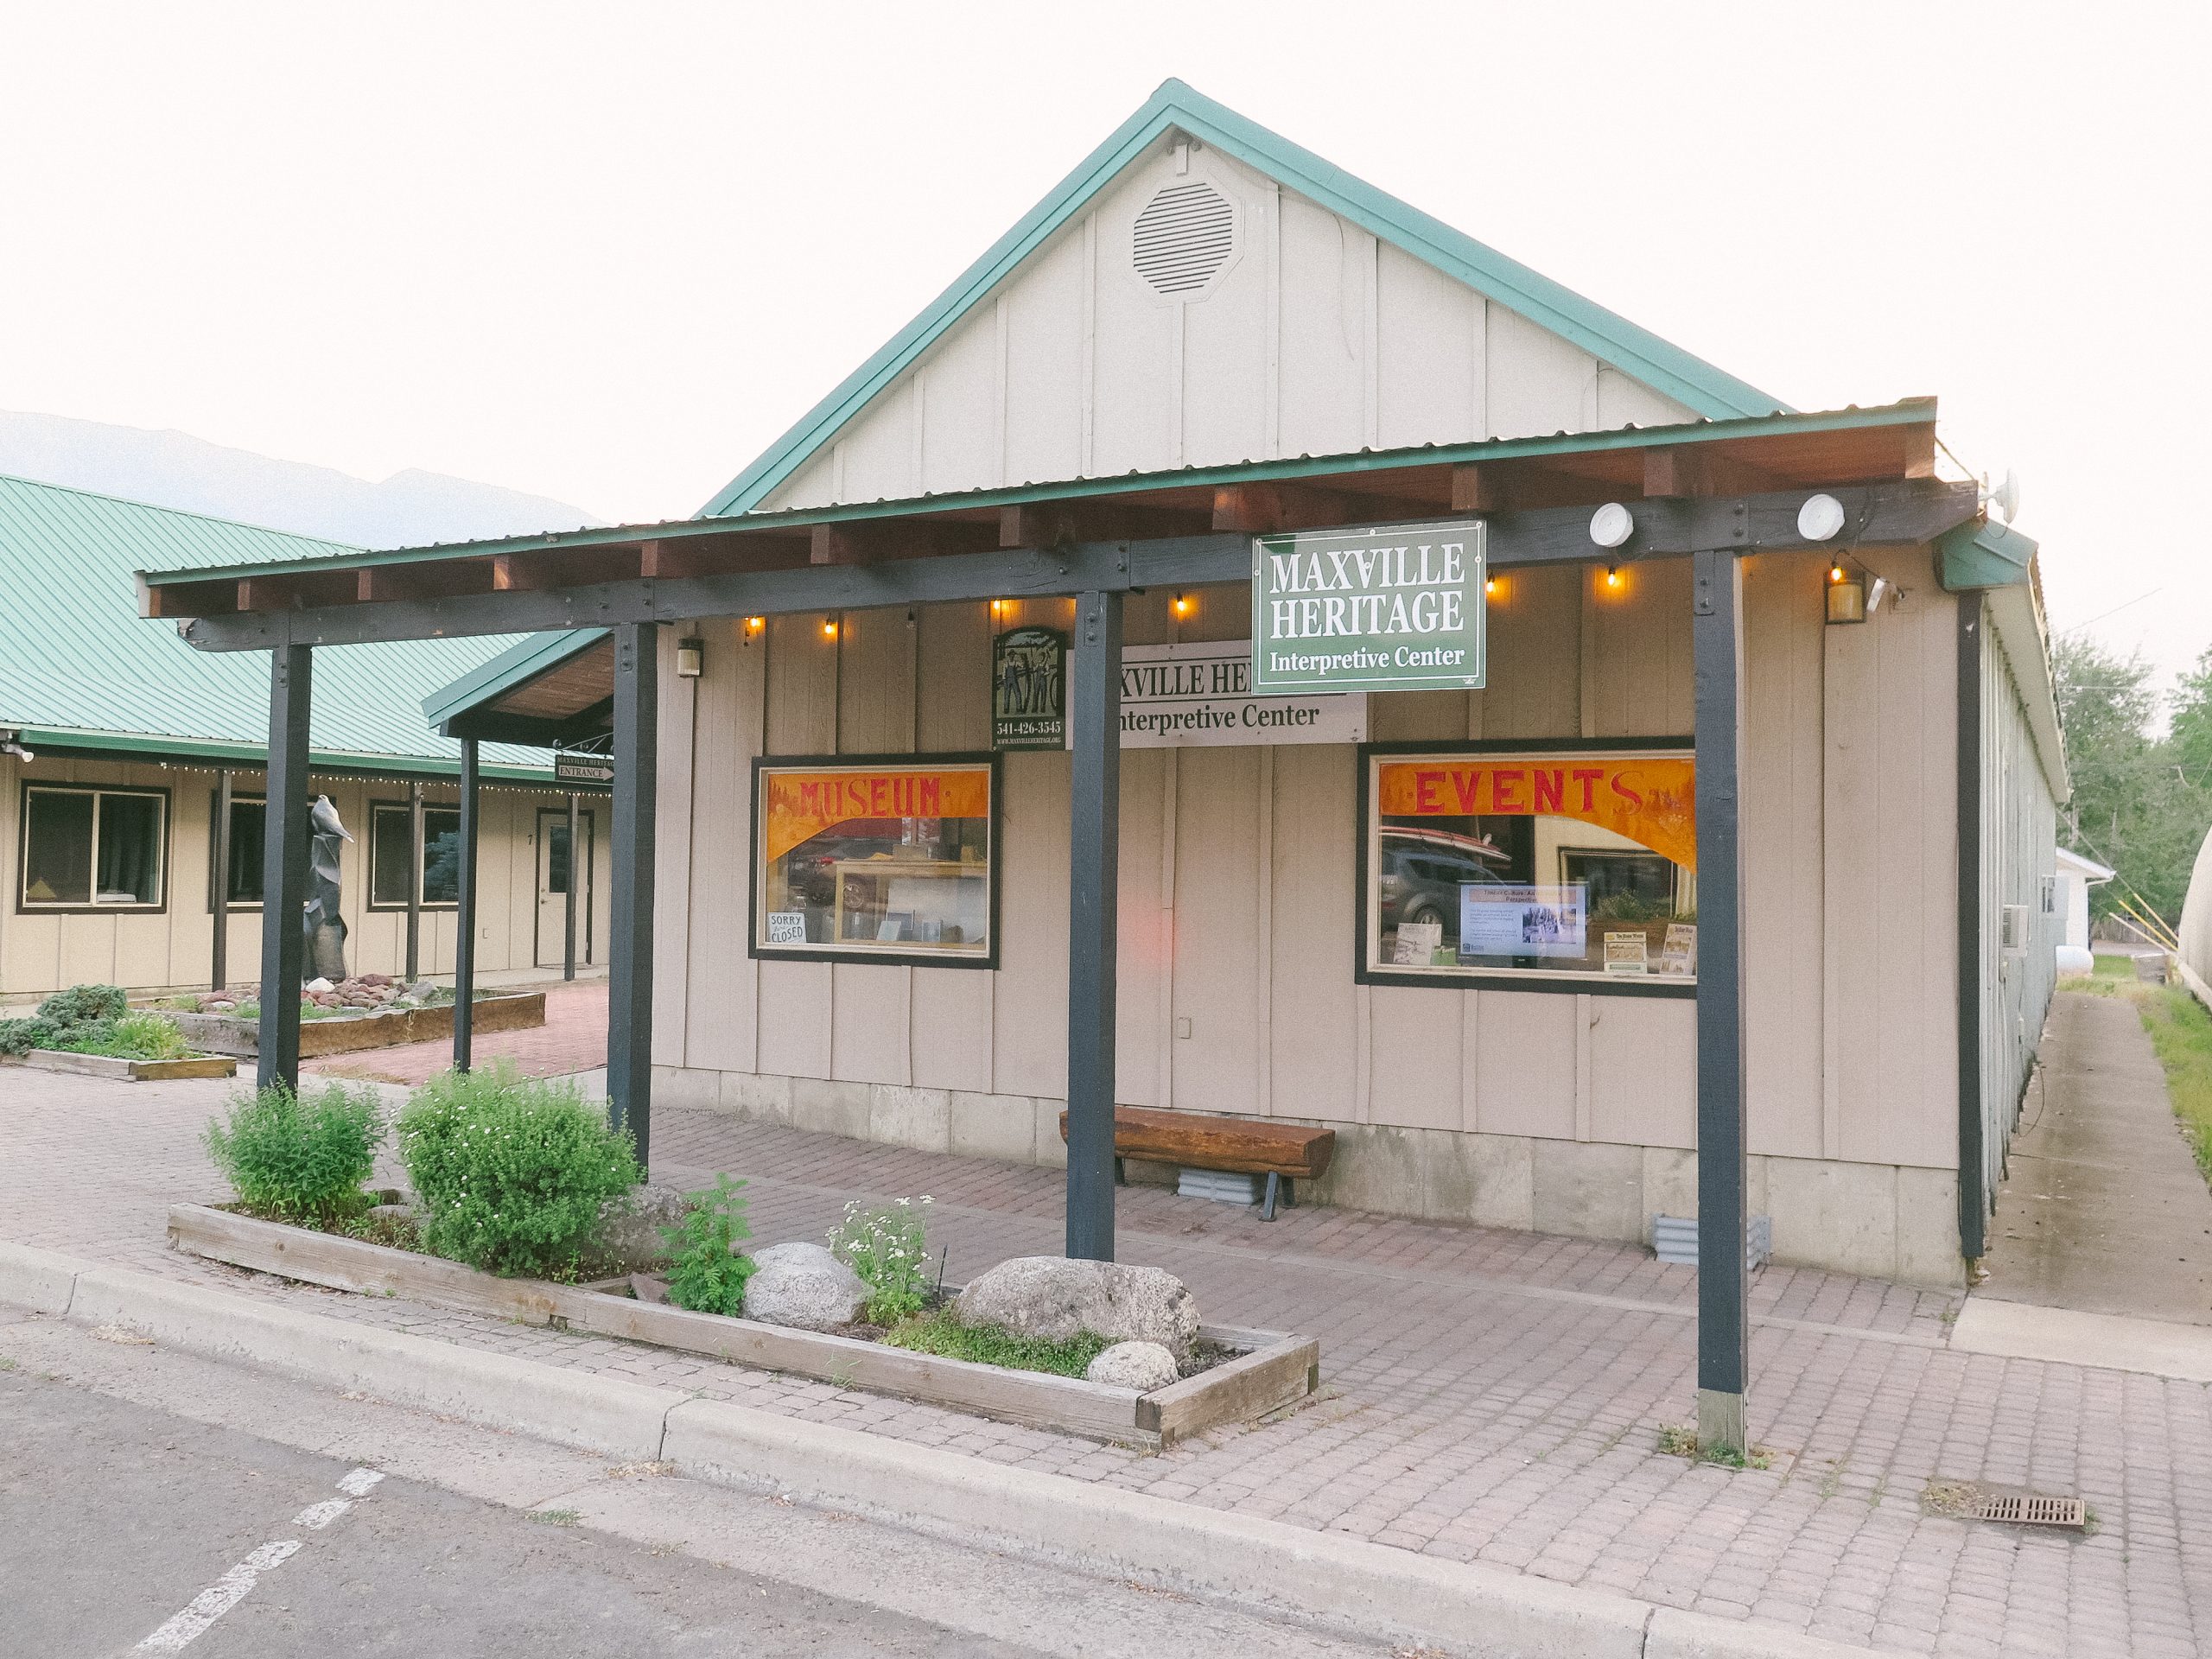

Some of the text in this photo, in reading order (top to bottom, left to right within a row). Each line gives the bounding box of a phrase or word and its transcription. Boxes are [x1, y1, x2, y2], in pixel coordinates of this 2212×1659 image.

[1269, 543, 1465, 594] MAXVILLE
[1270, 590, 1465, 639] HERITAGE
[1269, 645, 1465, 676] Interpretive Center
[1211, 662, 1251, 694] HE
[996, 721, 1061, 735] 541-426-3545
[1242, 703, 1320, 728] Center
[560, 766, 603, 778] ENTRANCE
[798, 777, 940, 817] MUSEUM
[1414, 768, 1642, 816] EVENTS
[771, 915, 801, 925] SORRY
[771, 925, 803, 943] CLOSED
